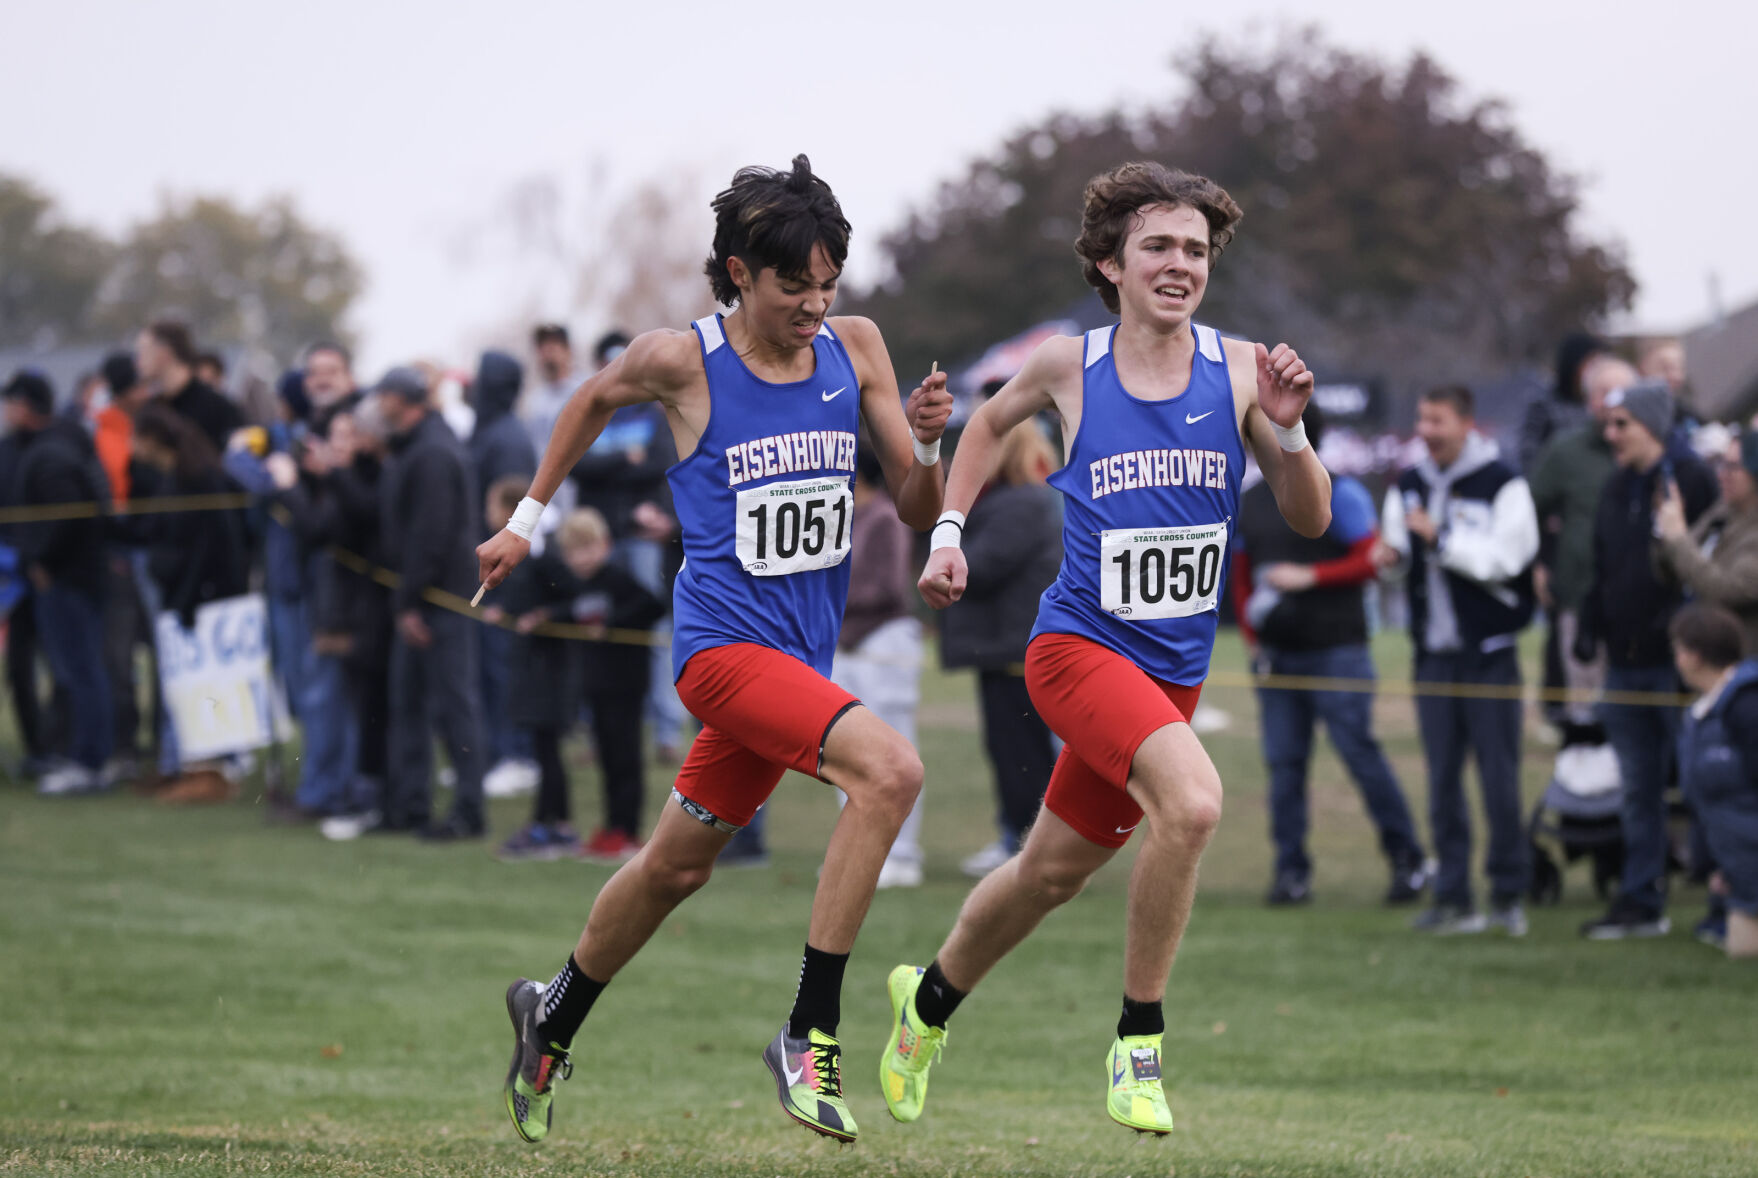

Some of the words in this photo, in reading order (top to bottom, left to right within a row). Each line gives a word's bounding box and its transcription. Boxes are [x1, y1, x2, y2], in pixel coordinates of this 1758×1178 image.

[725, 430, 856, 486] EISENHOWER
[1089, 448, 1227, 500] EISENHOWER
[769, 488, 794, 497] STATE
[795, 486, 817, 496] CROSS
[748, 495, 846, 559] 1051
[1133, 535, 1158, 543] STATE
[1159, 534, 1184, 542] CROSS
[1186, 531, 1219, 540] COUNTRY
[1112, 543, 1220, 604] 1050
